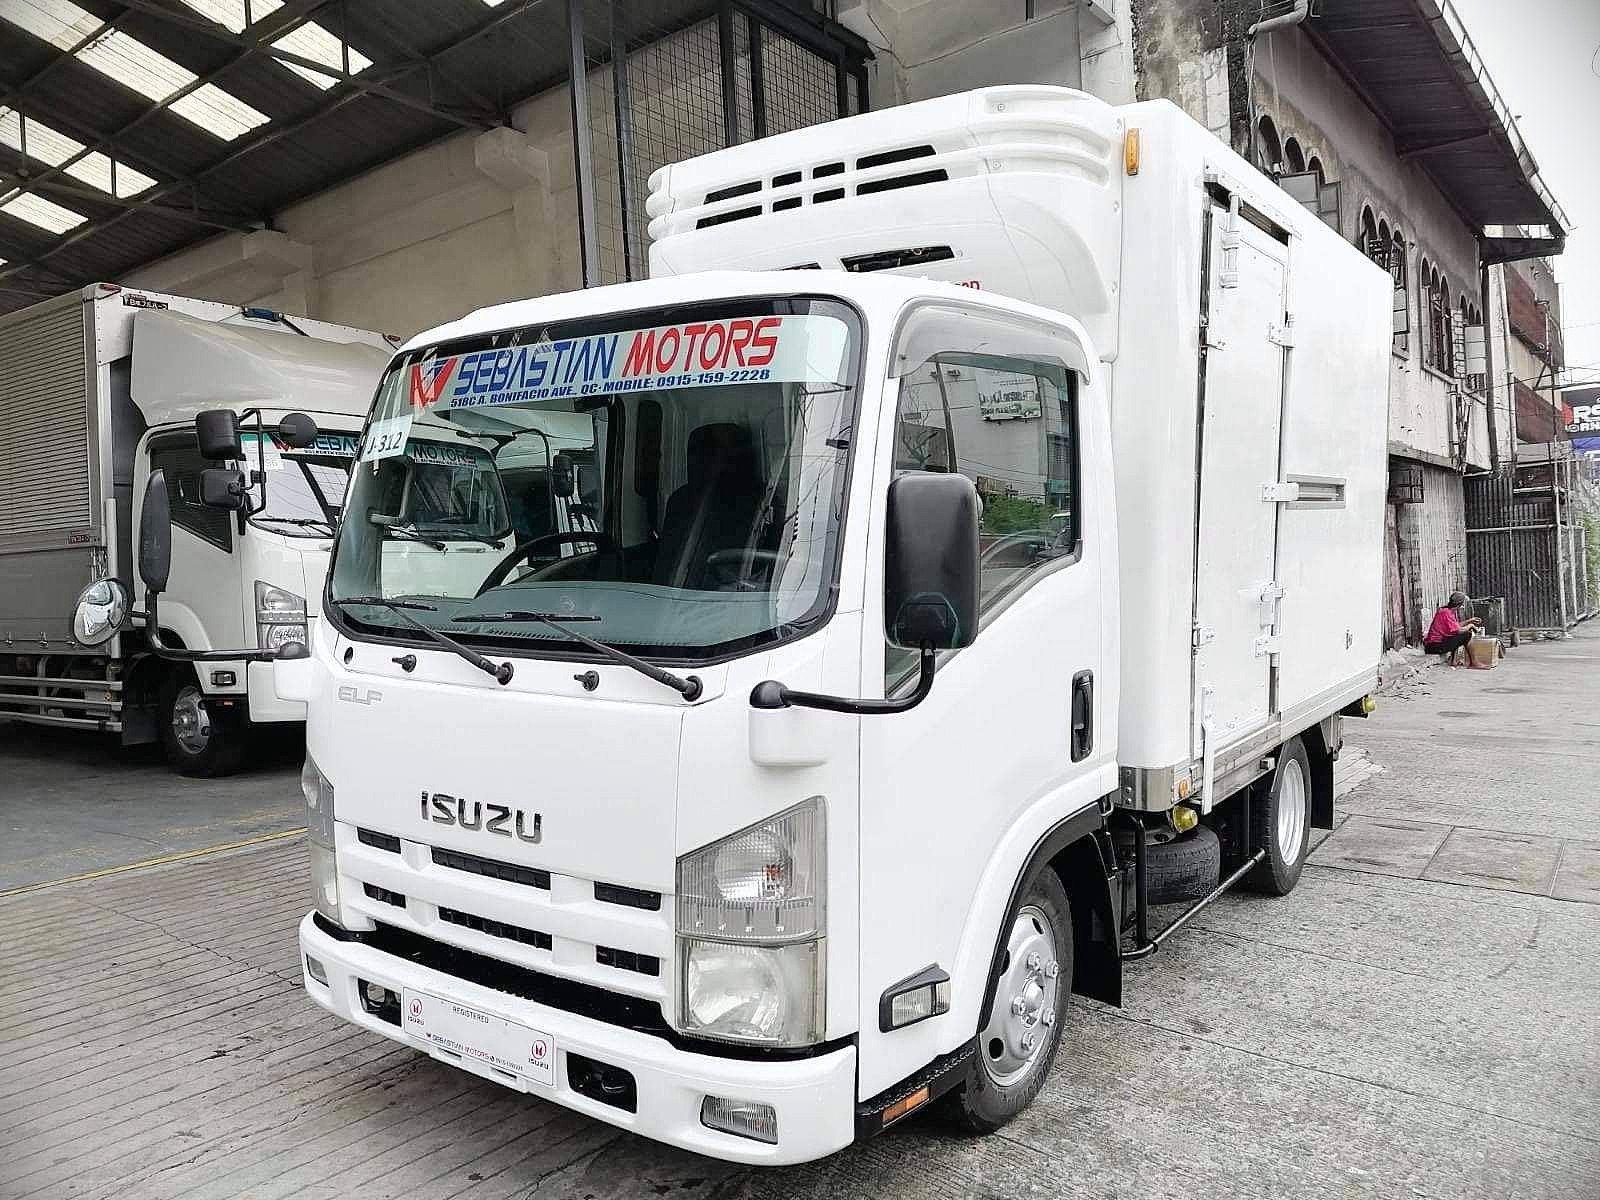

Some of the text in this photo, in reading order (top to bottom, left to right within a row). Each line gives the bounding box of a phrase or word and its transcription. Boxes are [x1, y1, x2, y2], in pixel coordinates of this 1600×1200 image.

[454, 317, 783, 395] SEBASTIAN MOTORS
[490, 388, 549, 404] BONIFACIO
[656, 369, 770, 388] 0915-159-2228
[338, 686, 383, 705] ELF
[420, 791, 542, 845] ISUZU
[407, 1015, 425, 1026] ISUZU
[452, 1005, 489, 1024] REGISTERED
[464, 1046, 490, 1060] MOTORS
[527, 1057, 549, 1070] ISUZU
